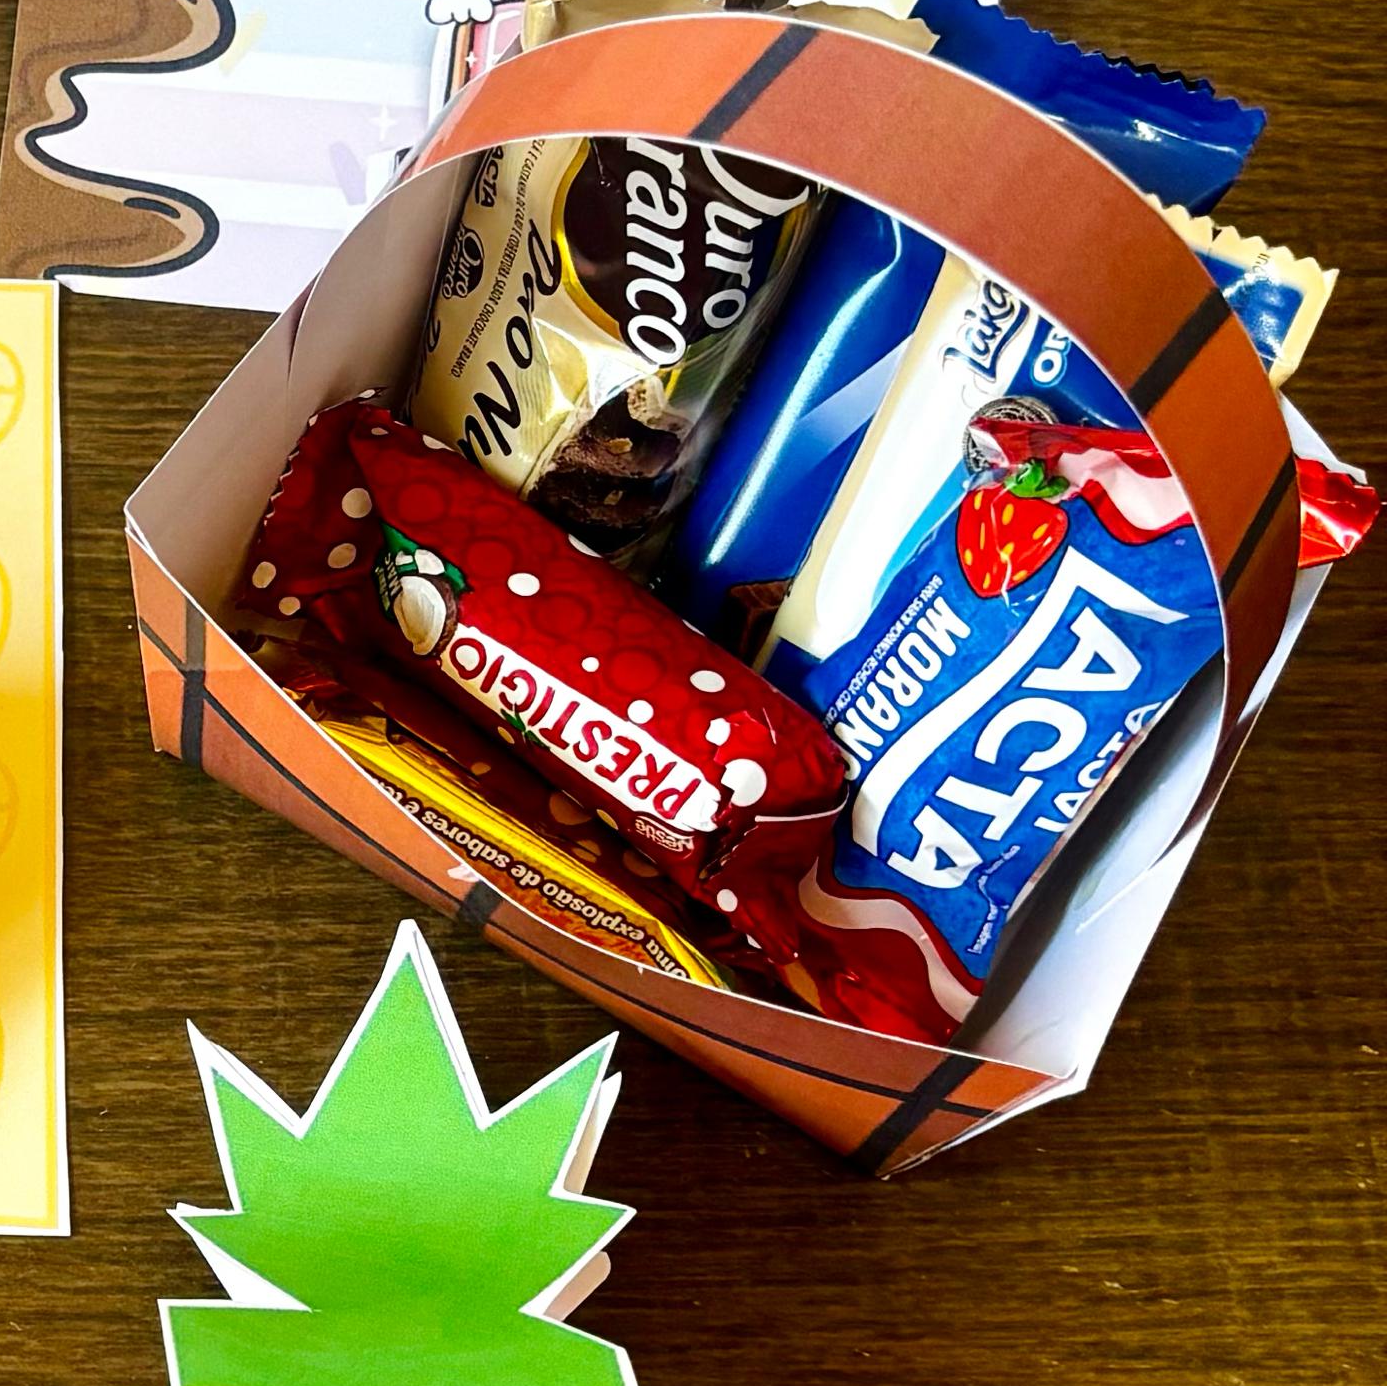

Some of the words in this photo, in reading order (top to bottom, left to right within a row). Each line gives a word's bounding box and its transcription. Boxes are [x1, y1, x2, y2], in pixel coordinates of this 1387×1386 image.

[480, 144, 505, 208] ACTA
[625, 137, 688, 370] ranco
[852, 545, 1190, 891] LACTA
[422, 808, 511, 868] sabores
[510, 862, 541, 887] de
[542, 881, 646, 943] explosão
